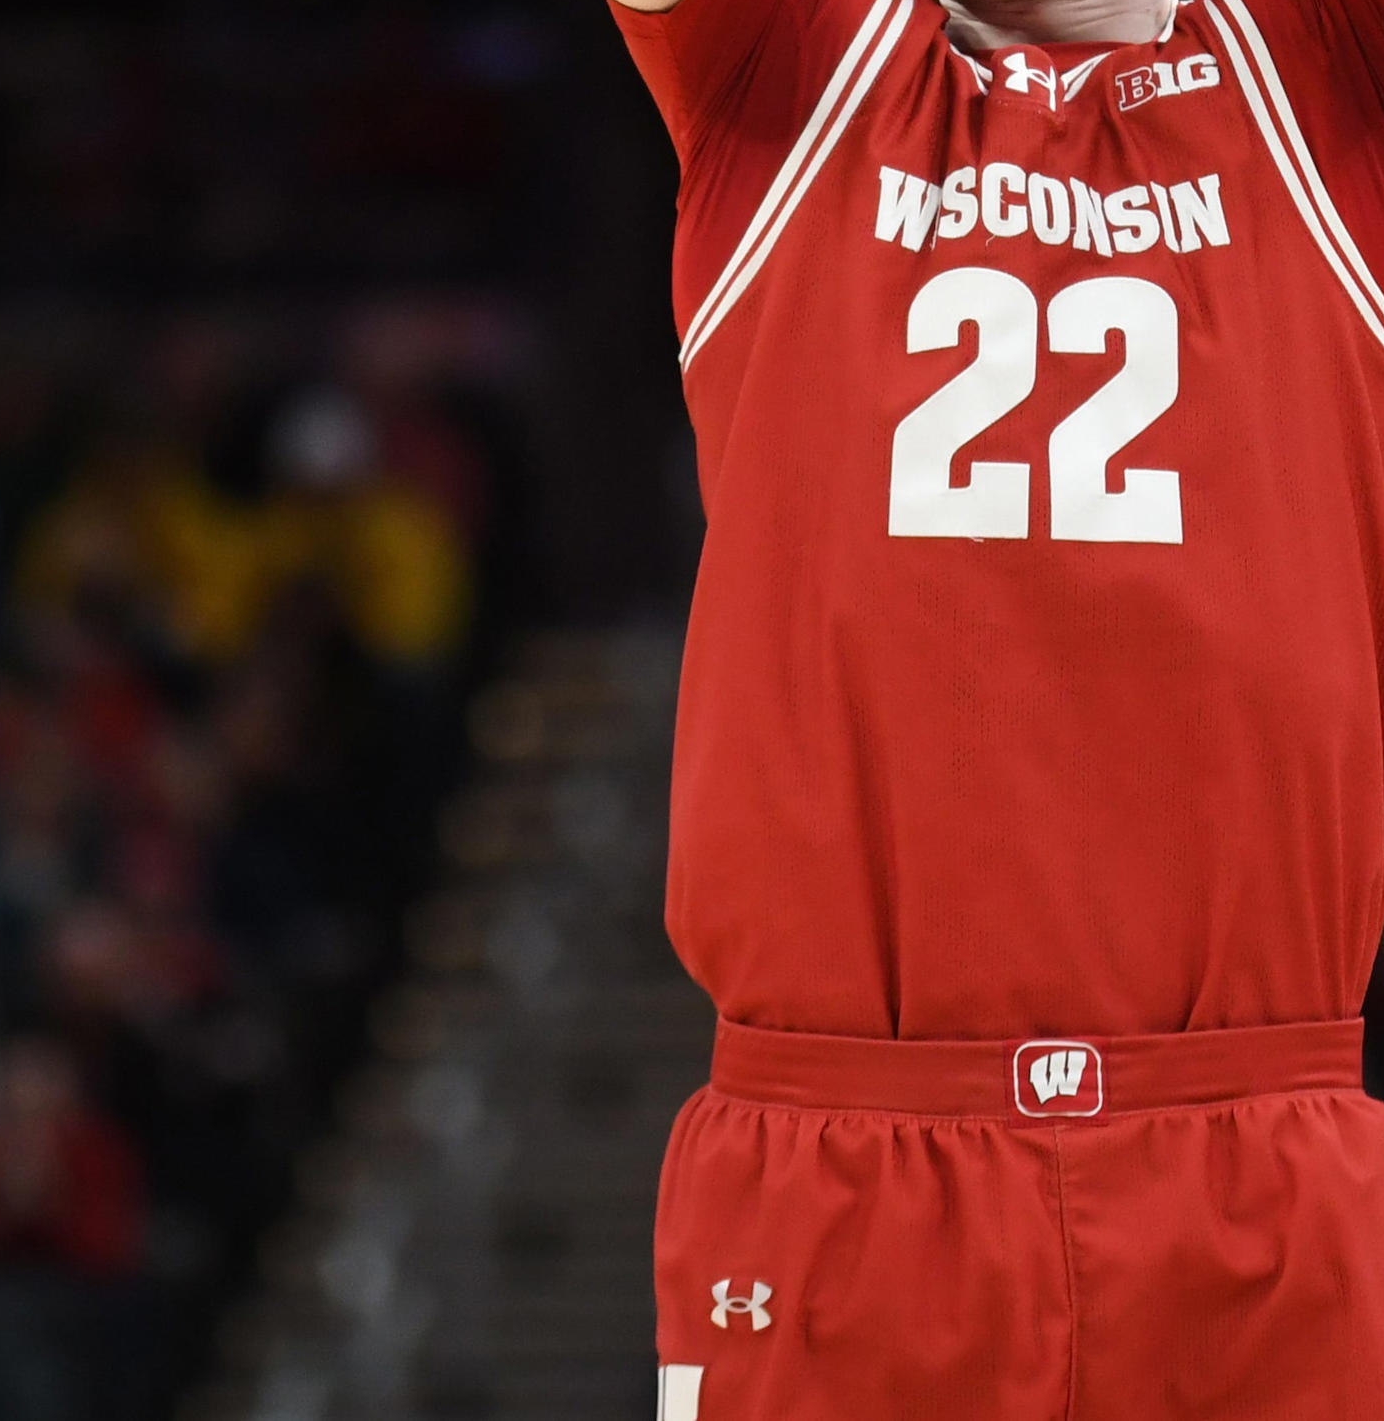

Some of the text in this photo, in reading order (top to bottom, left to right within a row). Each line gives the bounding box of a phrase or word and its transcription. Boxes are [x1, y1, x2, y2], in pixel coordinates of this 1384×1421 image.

[874, 162, 1231, 257] WSCONSIN
[888, 267, 1183, 545] 22
[1029, 1049, 1087, 1105] W
